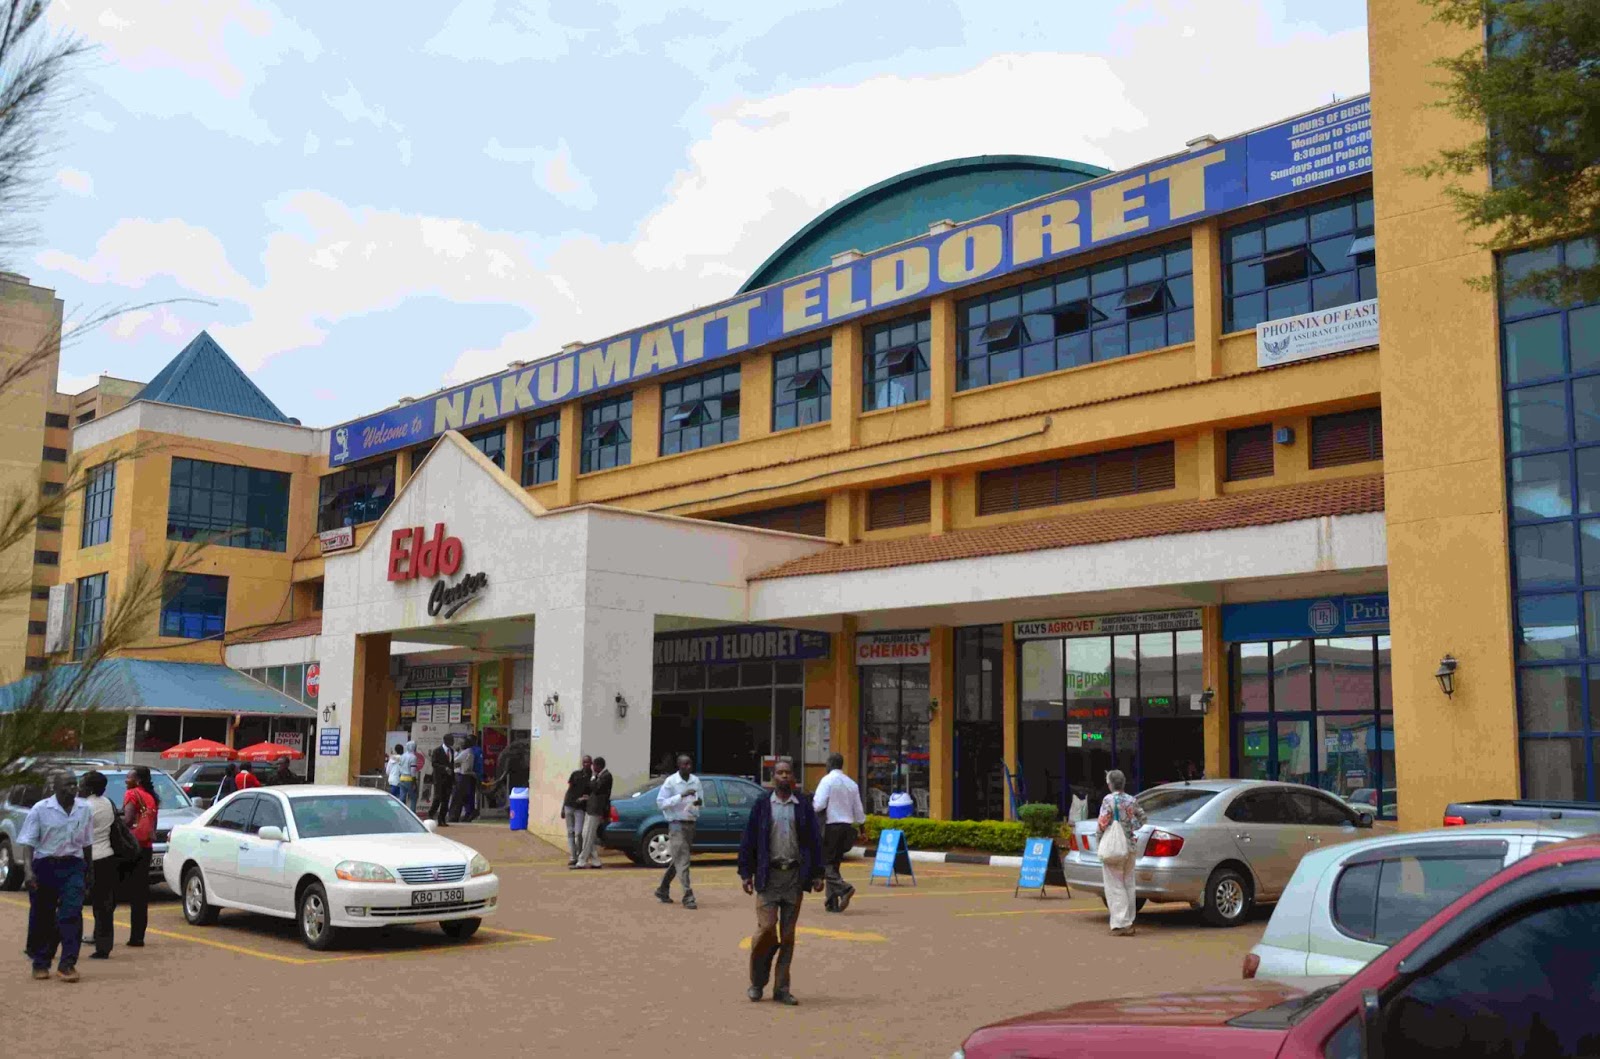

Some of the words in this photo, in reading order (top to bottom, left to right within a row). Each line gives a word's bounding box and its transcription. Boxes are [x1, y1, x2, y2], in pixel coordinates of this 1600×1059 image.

[1292, 116, 1325, 135] HOURS
[1326, 112, 1340, 124] OF
[1291, 129, 1331, 150] Monday
[1332, 126, 1343, 137] to
[1293, 145, 1331, 162] 8:30am
[1333, 139, 1344, 150] to
[1270, 161, 1312, 181] Sundays
[1314, 154, 1333, 168] and
[1335, 144, 1369, 163] Public
[1291, 170, 1334, 187] 10:00am
[1336, 164, 1347, 175] to
[1348, 156, 1372, 171] 8:00
[433, 295, 763, 434] NAKUMATT
[781, 149, 1226, 335] ELDORET
[1262, 315, 1321, 338] PHOENIX
[1323, 310, 1342, 325] OF
[1292, 324, 1341, 342] ASSURANCE
[362, 421, 408, 449] Welcome
[411, 416, 422, 434] to
[387, 523, 463, 581] Eldo
[1017, 622, 1047, 635] KALYS
[722, 629, 799, 659] ELDORET
[860, 641, 930, 658] CHEMIST
[411, 666, 448, 680] FUJIFILM
